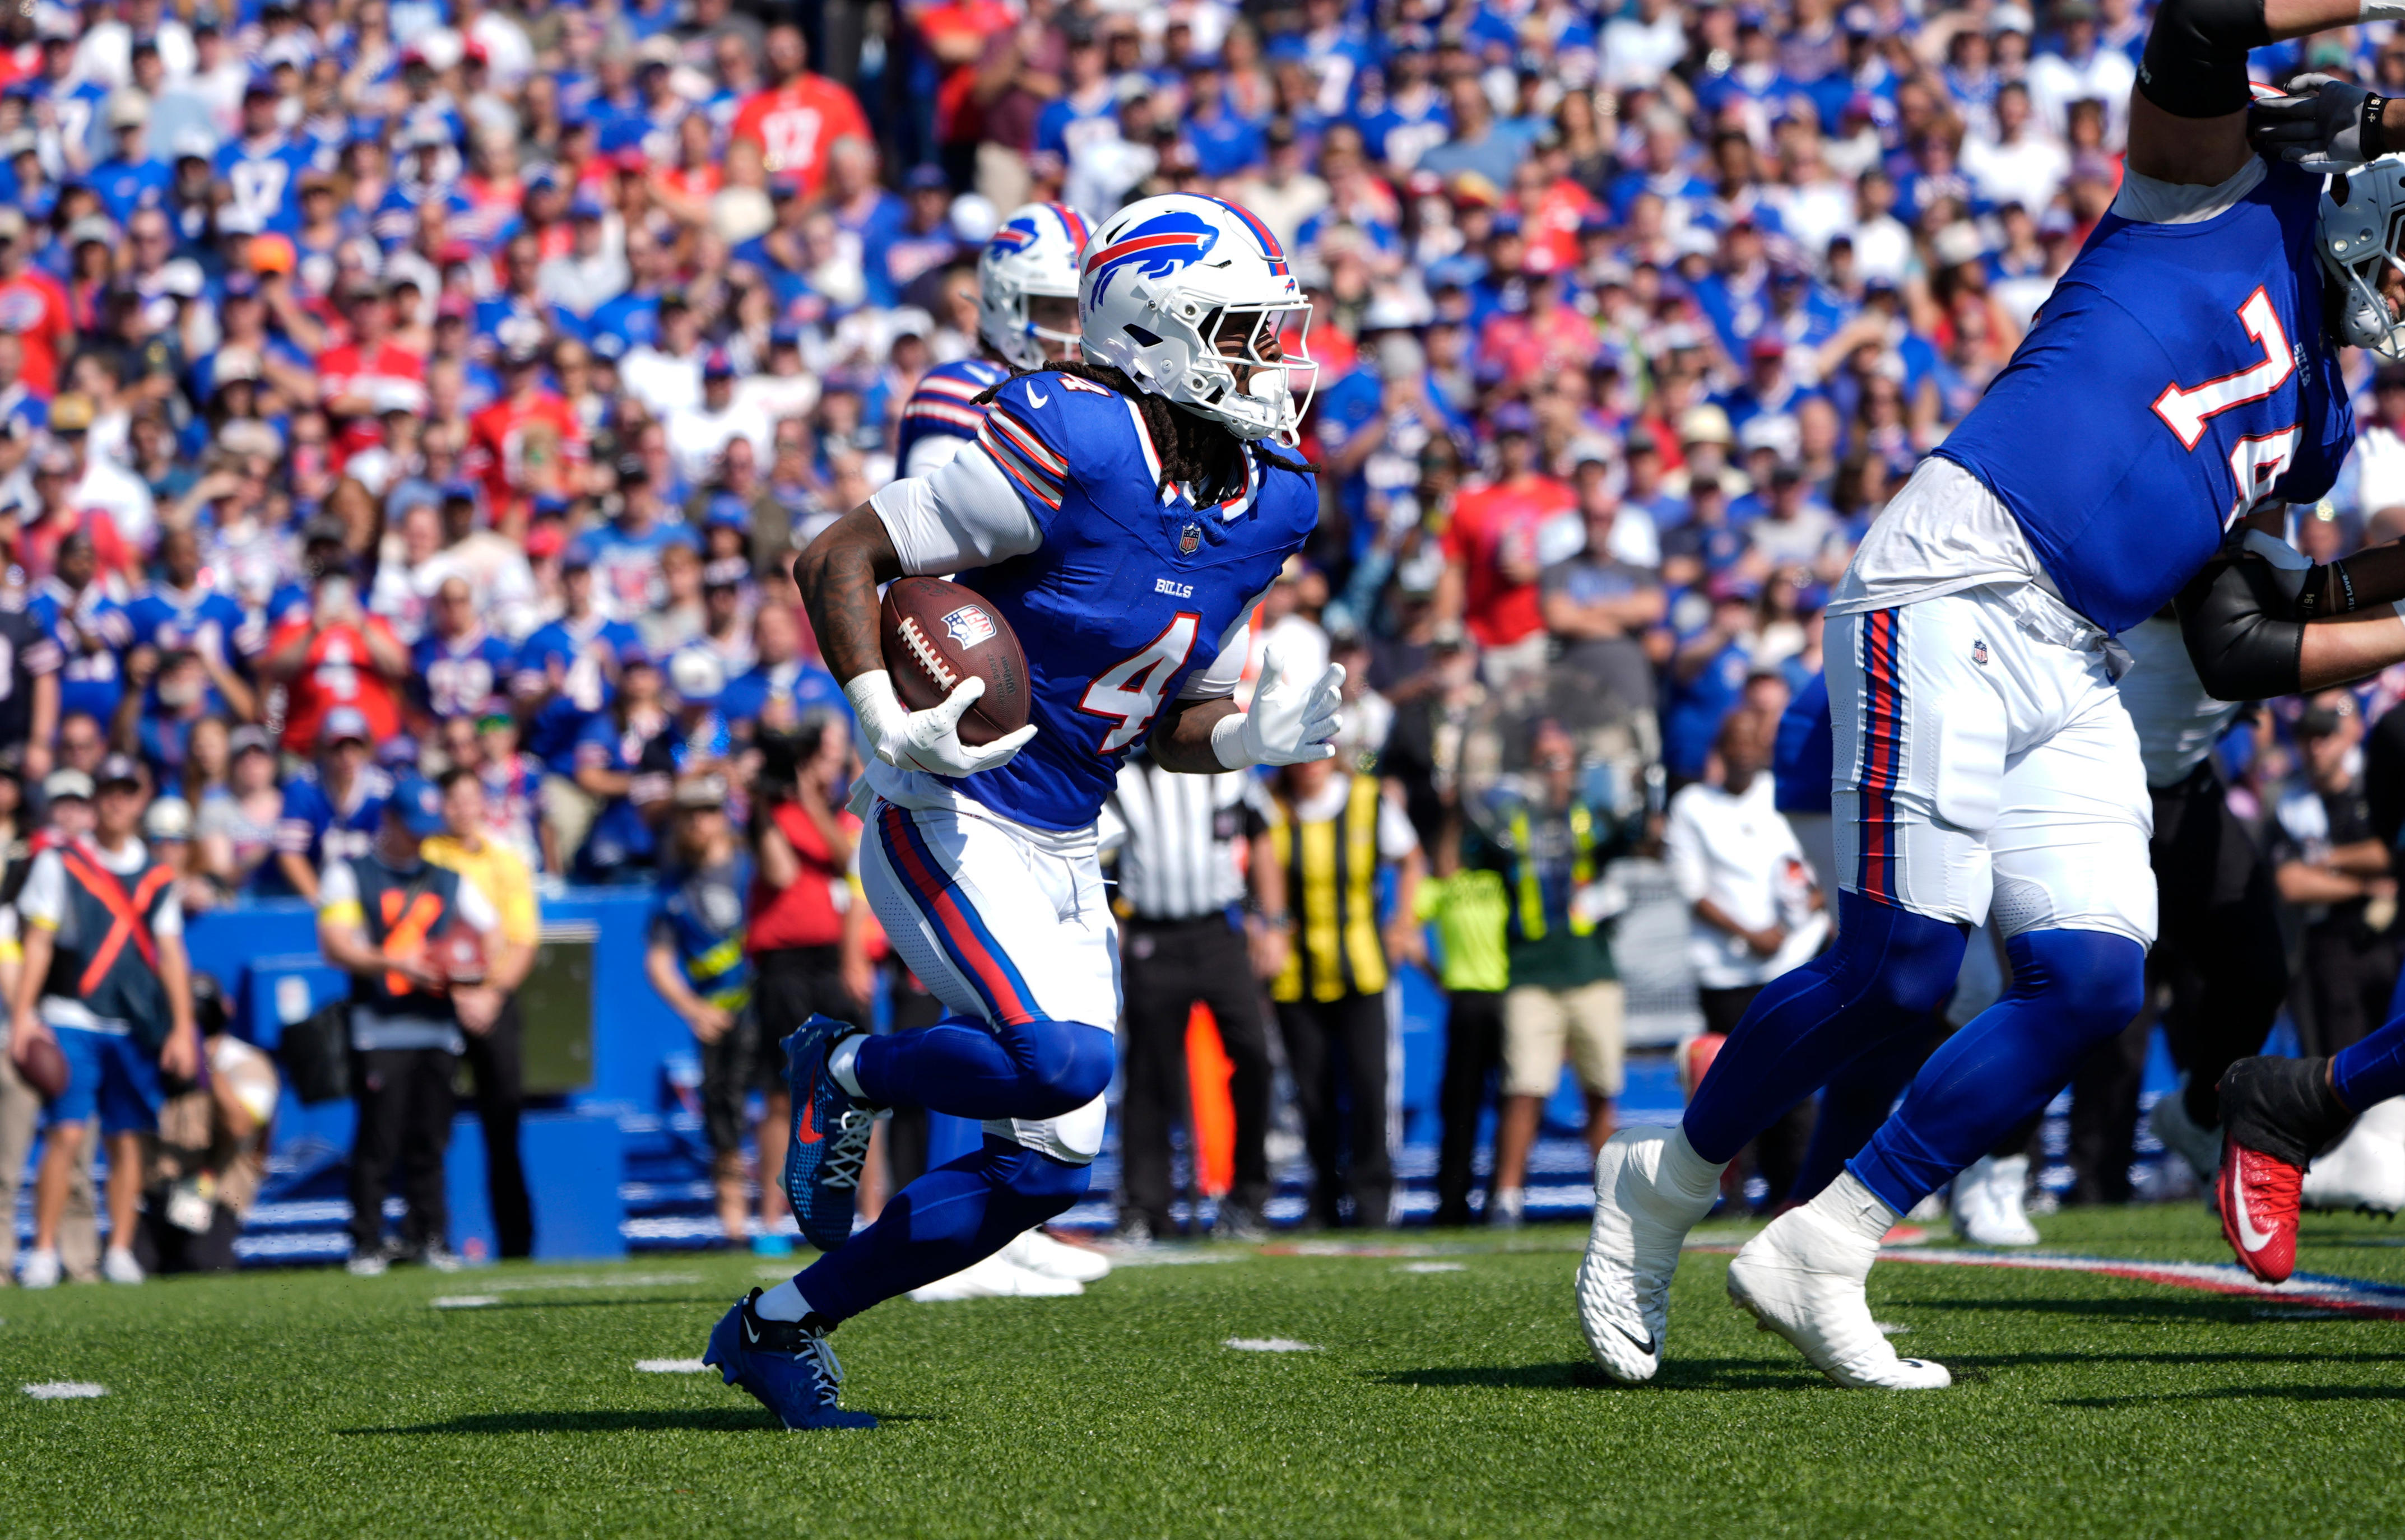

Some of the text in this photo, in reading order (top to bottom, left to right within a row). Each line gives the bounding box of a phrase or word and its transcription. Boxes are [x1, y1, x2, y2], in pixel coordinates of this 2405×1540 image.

[2294, 342, 2311, 387] BILLS
[1182, 537, 1196, 550] NFL
[1155, 578, 1194, 599] BILLS
[2304, 593, 2315, 604] 94
[963, 607, 992, 634] NFL
[1075, 611, 1201, 756] 4
